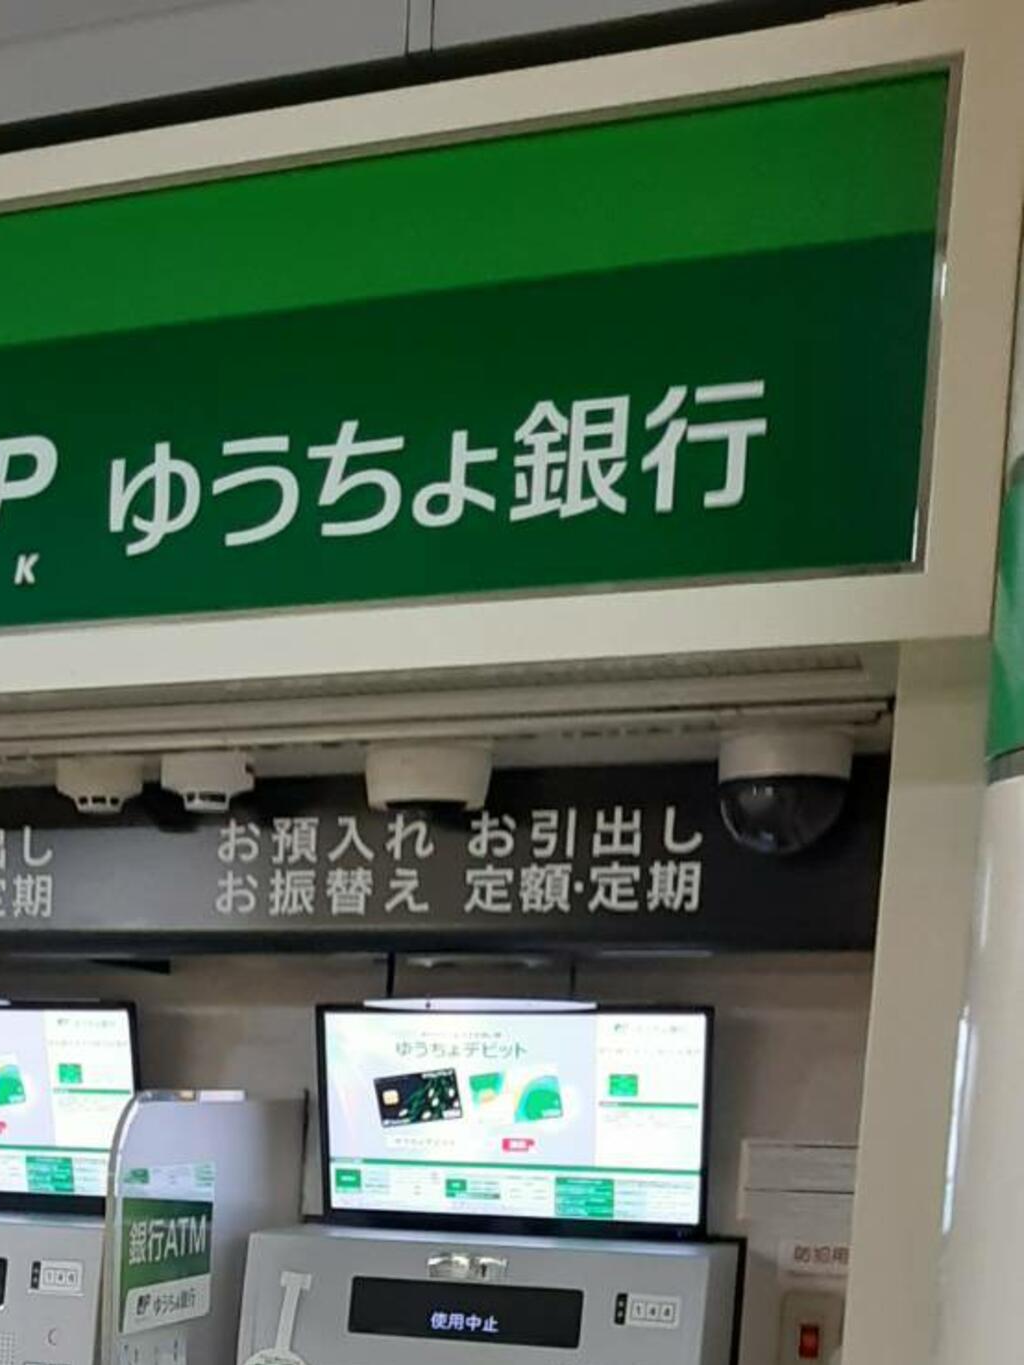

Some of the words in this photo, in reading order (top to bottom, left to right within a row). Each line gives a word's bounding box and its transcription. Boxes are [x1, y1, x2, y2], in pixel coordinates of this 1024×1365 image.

[108, 380, 768, 557] ゆうちょ銀行
[217, 814, 435, 864] お預入れ
[467, 805, 703, 859] お引出し
[215, 867, 430, 916] お振替え
[395, 1039, 529, 1061] ゆうちょデビット
[128, 1214, 207, 1266] 銀行ATM
[430, 1311, 499, 1335] 使用中止
